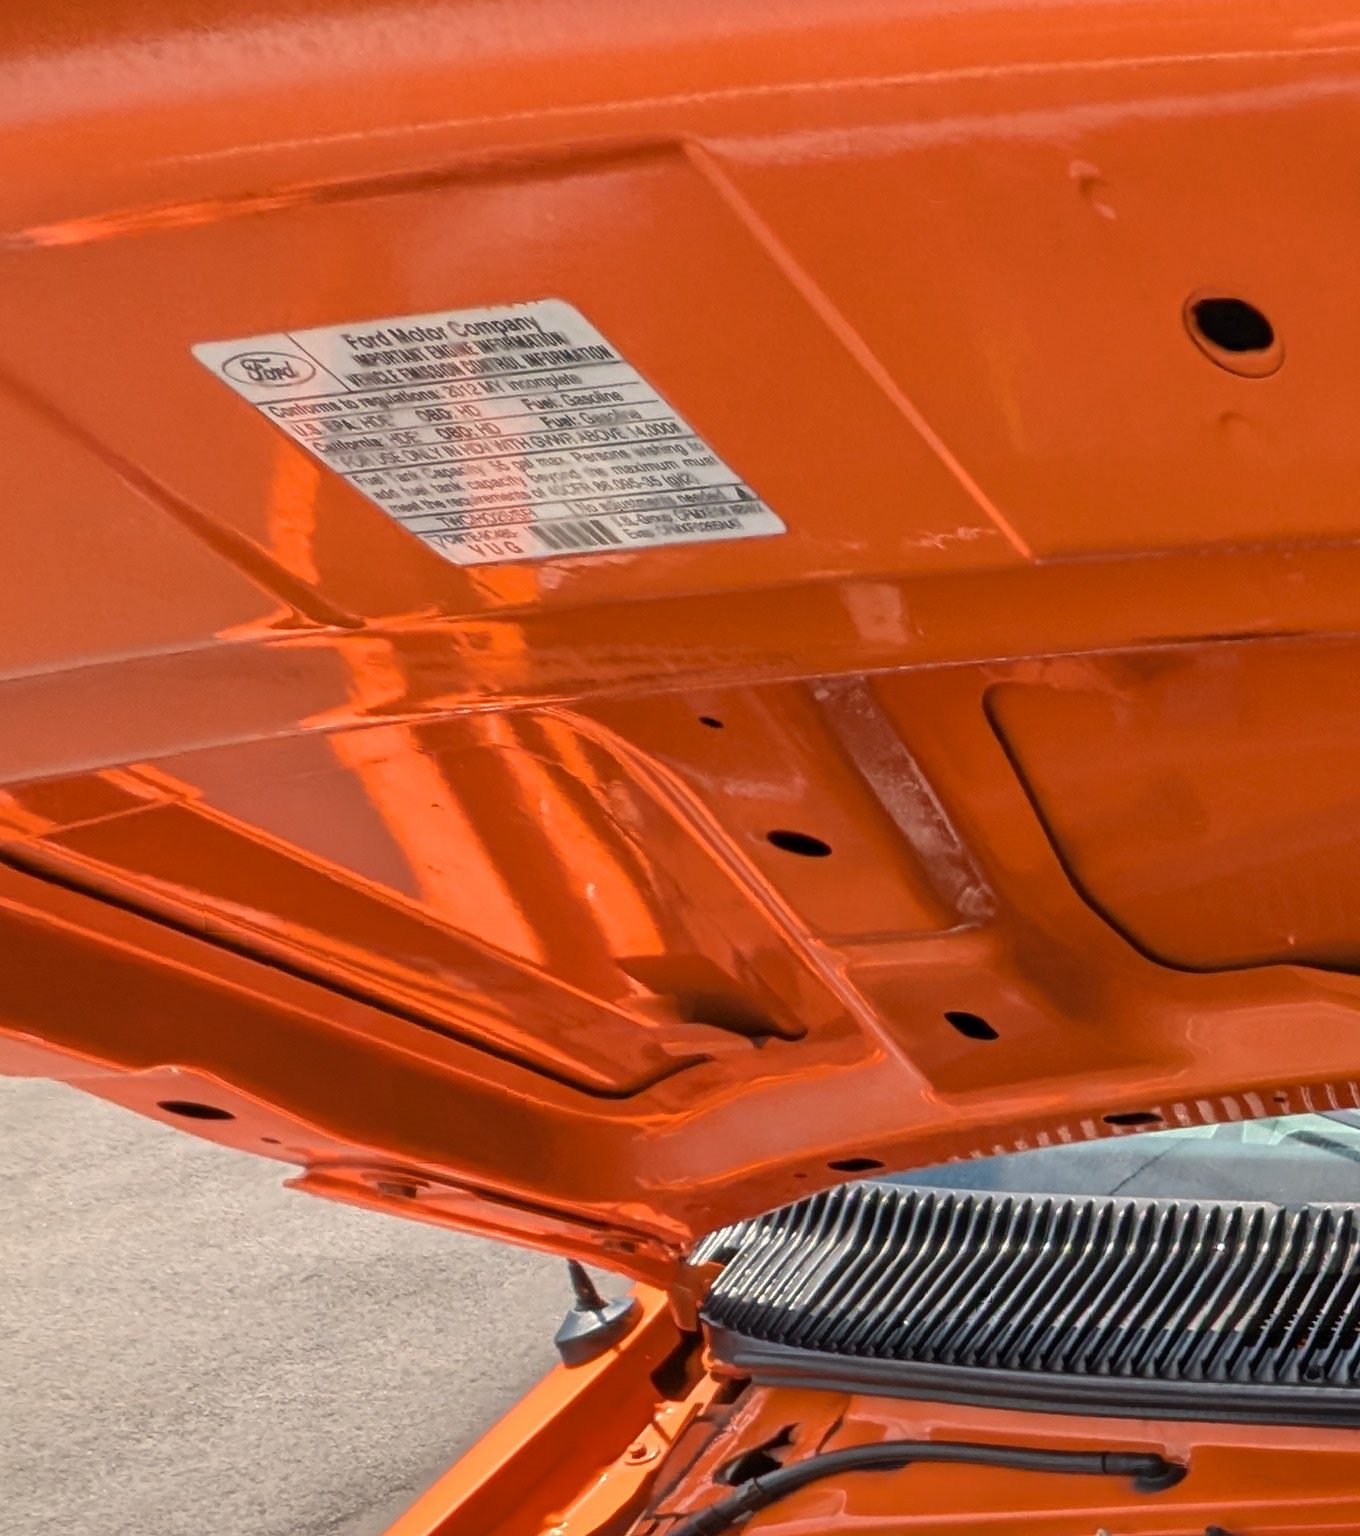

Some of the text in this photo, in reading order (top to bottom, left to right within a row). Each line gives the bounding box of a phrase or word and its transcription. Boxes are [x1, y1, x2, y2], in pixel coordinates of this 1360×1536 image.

[340, 312, 545, 349] Ford Motor Company
[351, 331, 568, 367] IMPORTANT ENGINE INFORMATION
[239, 357, 301, 380] Ford
[343, 345, 614, 386] VEHICLE EMISSION CONTROL INFORMATION
[265, 371, 586, 417] Conforms to regulations: 2012 MY incomplete
[453, 404, 483, 417] HD
[558, 388, 624, 406] Gasoline
[472, 422, 503, 435] HD
[537, 413, 582, 428] Fuel:
[350, 473, 385, 485] Fuel
[383, 469, 422, 482] Tank
[569, 447, 632, 463] Persons
[629, 442, 689, 459] wishing
[369, 451, 407, 464] USE
[399, 446, 447, 461] ONLY
[439, 444, 464, 456] IN
[489, 436, 533, 451] WITH
[572, 426, 629, 442] ABOVE
[429, 481, 465, 493] tank
[463, 475, 529, 491] capacity
[526, 469, 584, 484] beyond
[609, 459, 680, 475] maximum
[679, 455, 718, 467] must
[386, 502, 424, 513] meet
[419, 498, 447, 509] the
[527, 487, 549, 497] of
